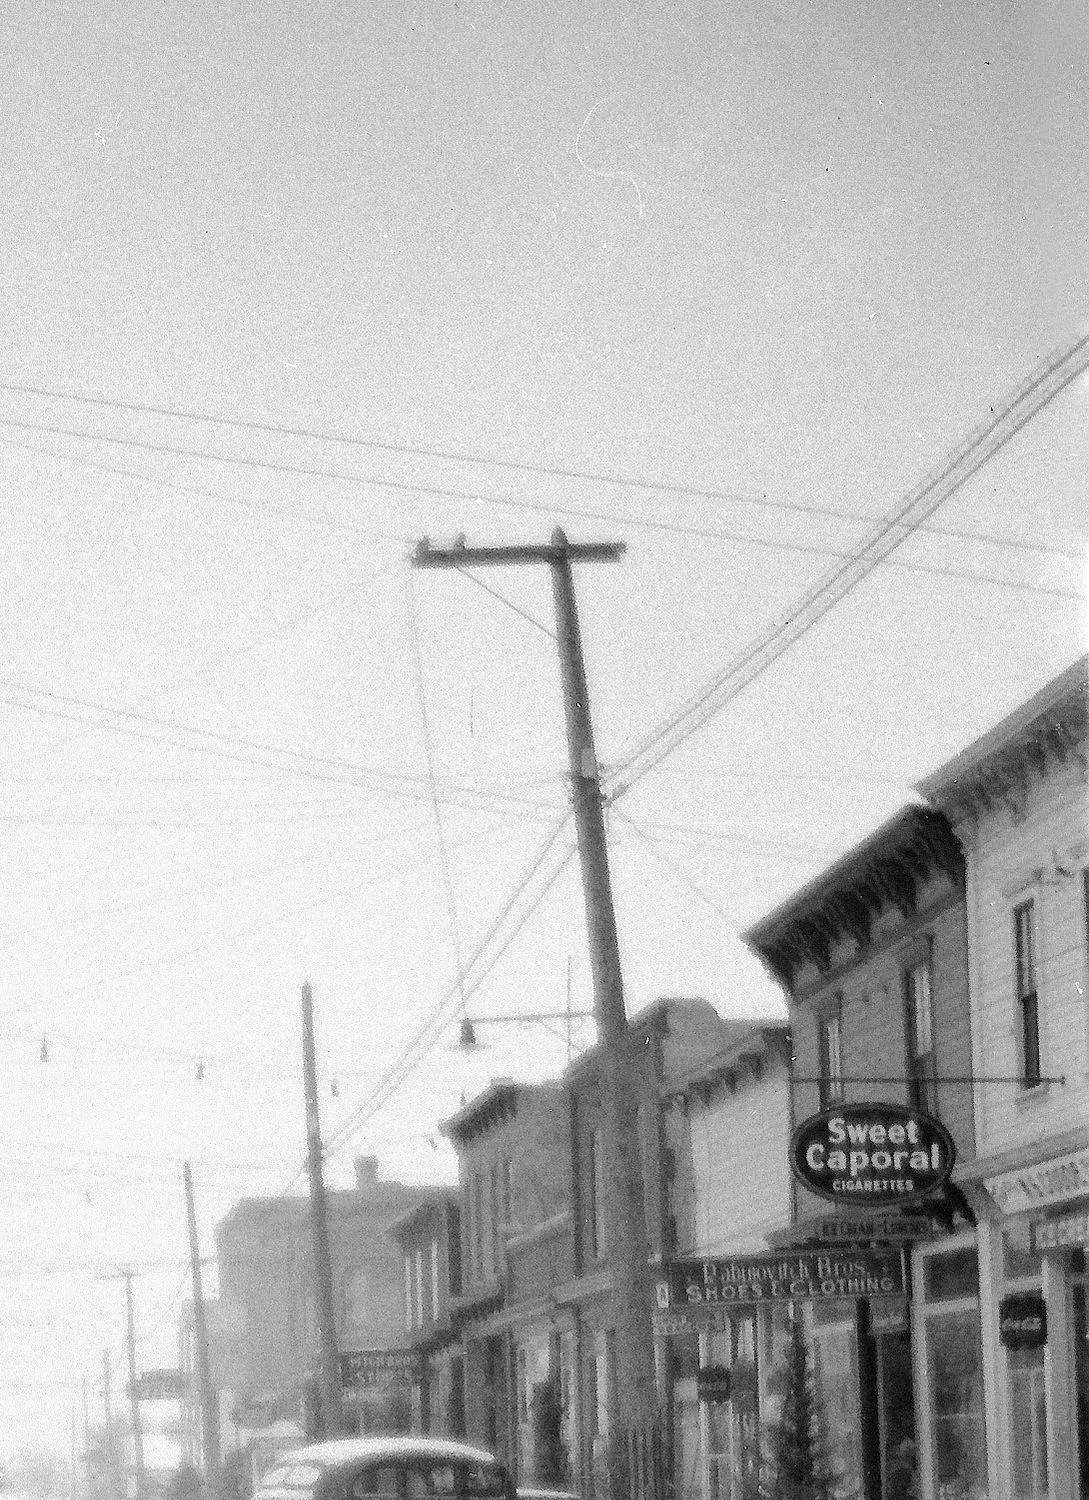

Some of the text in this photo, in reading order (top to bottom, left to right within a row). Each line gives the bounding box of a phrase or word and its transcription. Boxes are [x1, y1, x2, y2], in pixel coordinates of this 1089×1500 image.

[827, 1117, 918, 1144] Sweet
[806, 1143, 940, 1176] Caporal
[832, 1179, 914, 1192] CIGARETTES
[686, 1283, 762, 1304] SHOES
[789, 1277, 894, 1298] CLOTHING
